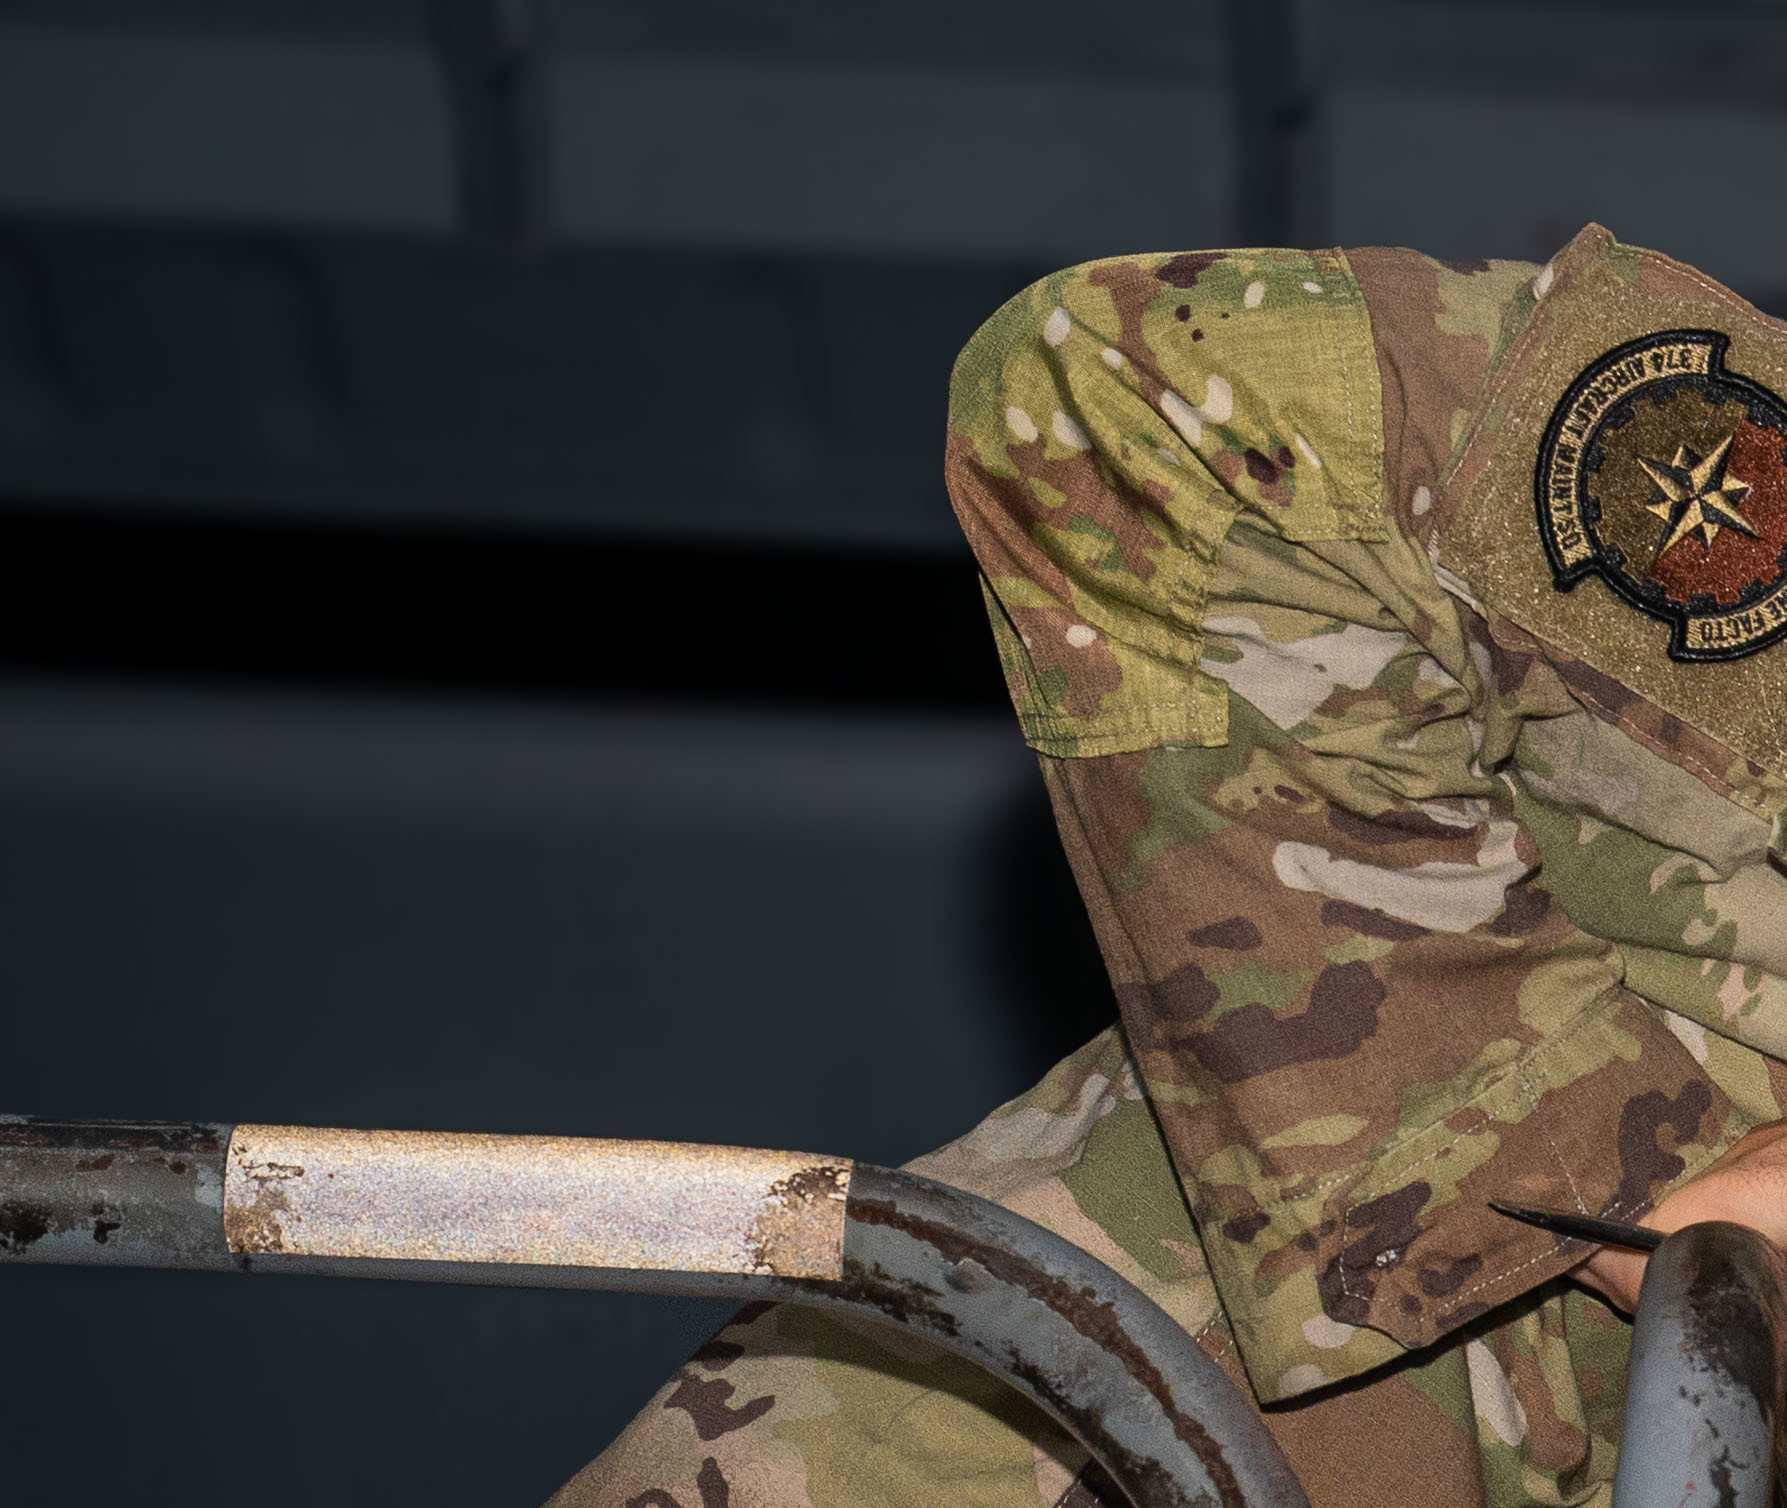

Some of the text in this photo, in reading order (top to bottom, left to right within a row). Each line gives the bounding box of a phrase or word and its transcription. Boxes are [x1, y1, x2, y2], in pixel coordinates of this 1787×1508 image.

[1652, 349, 1692, 373] 374
[1564, 356, 1646, 439] AIRCRAFT
[1551, 444, 1577, 515] MAINT
[1701, 610, 1766, 642] FACTO
